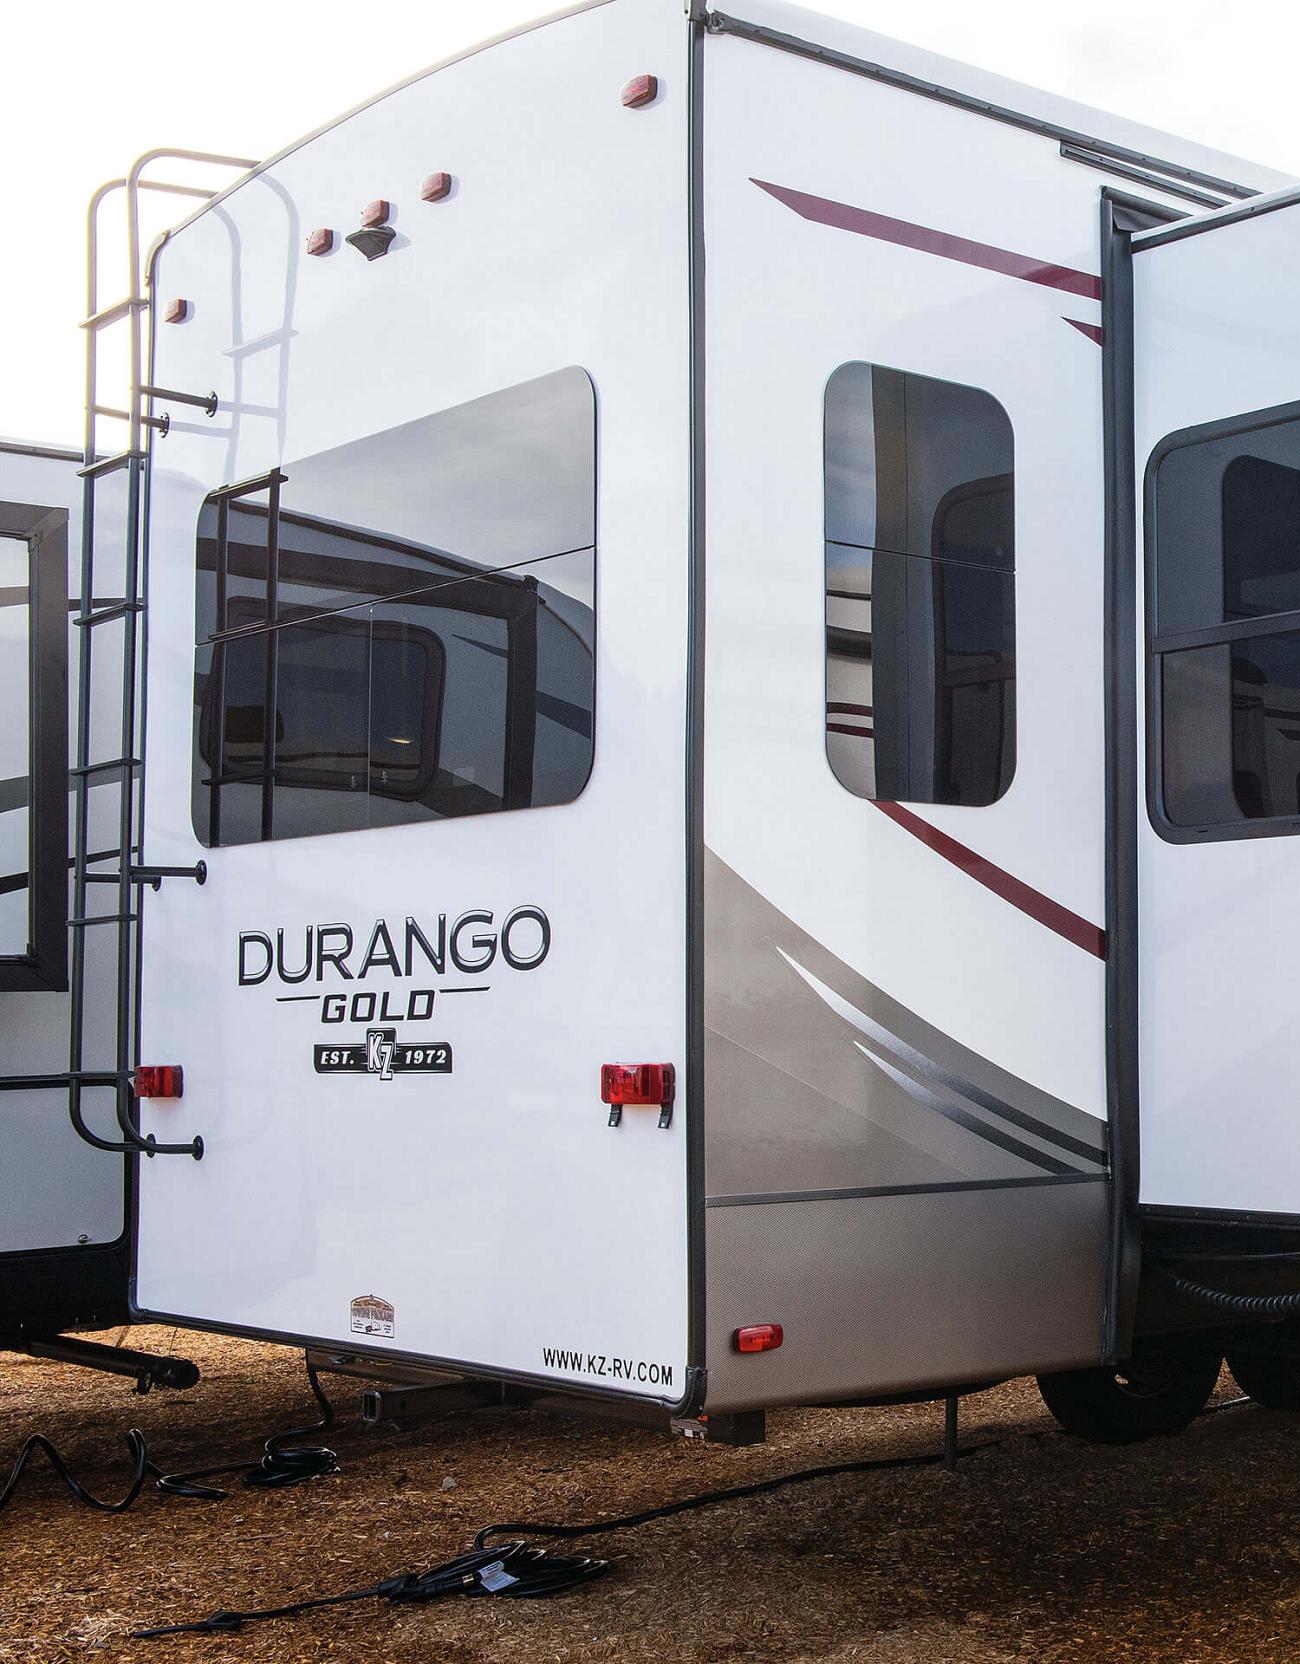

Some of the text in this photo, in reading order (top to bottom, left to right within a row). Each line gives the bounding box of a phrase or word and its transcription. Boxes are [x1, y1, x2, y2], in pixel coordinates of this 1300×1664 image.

[238, 904, 551, 986] DURANGO
[321, 989, 436, 1023] GOLD
[320, 1032, 447, 1080] EST. KZ 1972
[542, 1347, 673, 1386] WWW.KZ-RV.COM
